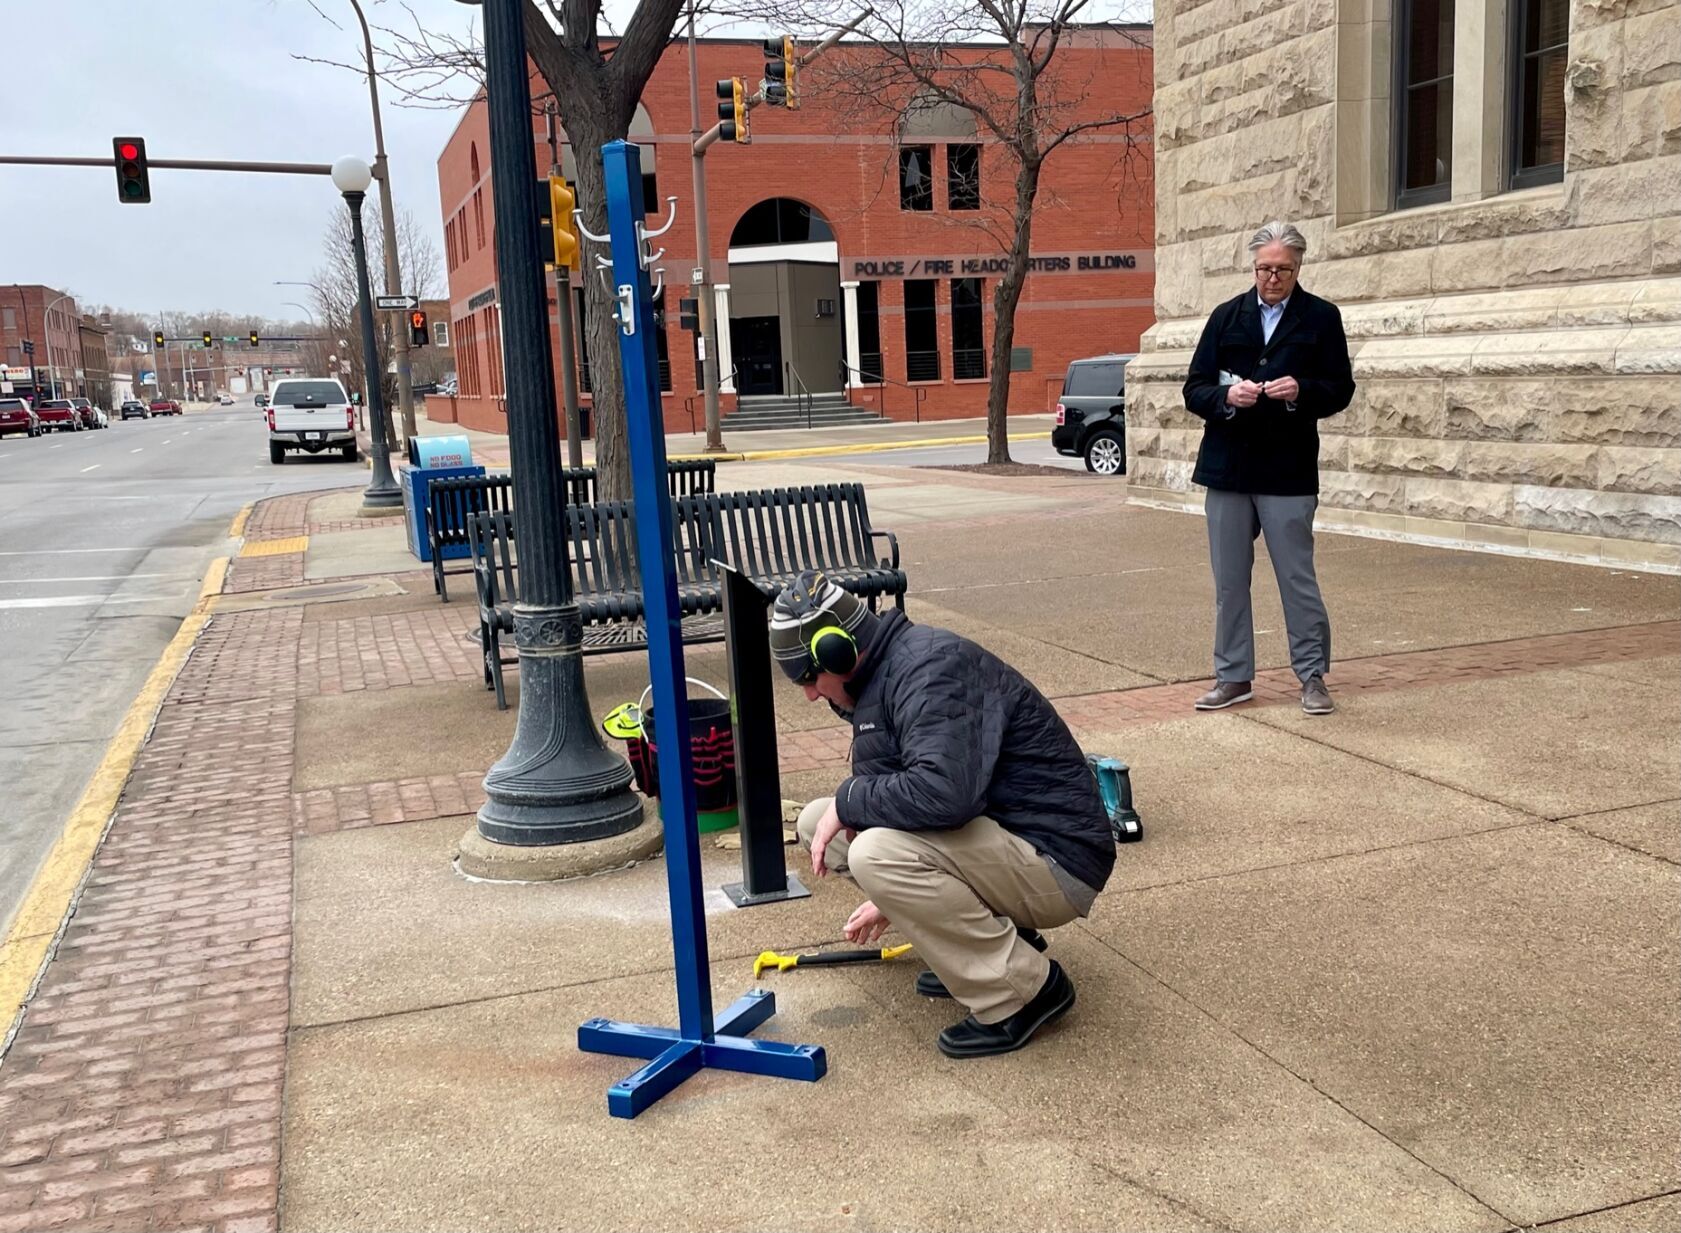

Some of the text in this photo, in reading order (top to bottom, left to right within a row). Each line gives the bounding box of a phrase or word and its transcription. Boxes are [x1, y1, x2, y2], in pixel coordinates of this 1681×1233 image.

[854, 260, 904, 277] POLICE
[909, 259, 921, 276] /
[924, 259, 954, 275] FIRE
[1077, 254, 1137, 271] BUILDING
